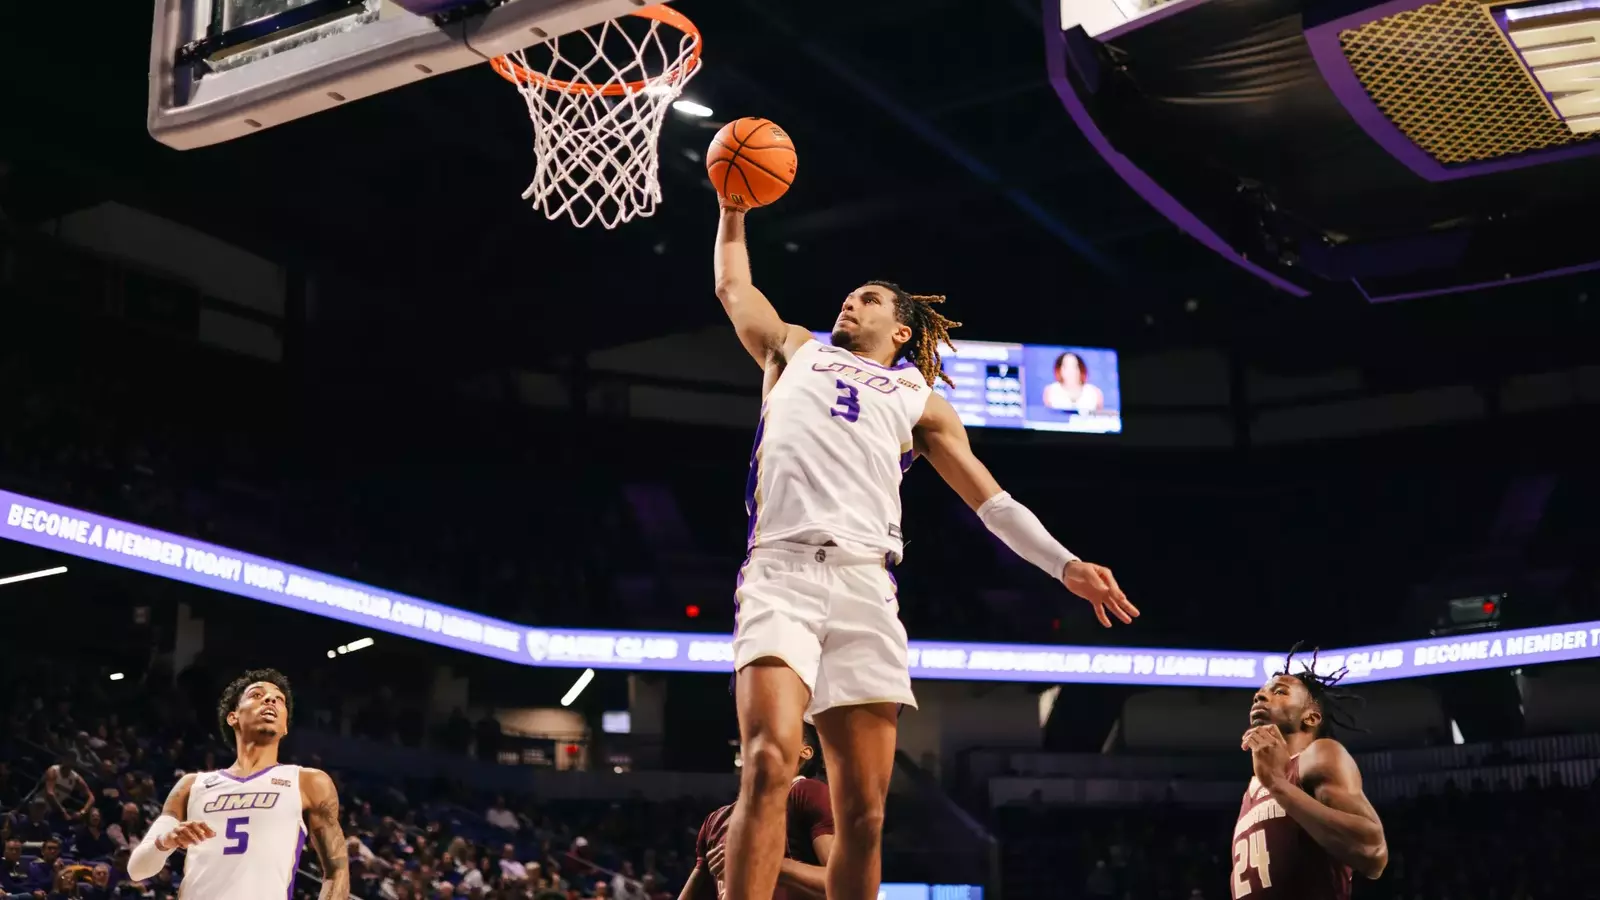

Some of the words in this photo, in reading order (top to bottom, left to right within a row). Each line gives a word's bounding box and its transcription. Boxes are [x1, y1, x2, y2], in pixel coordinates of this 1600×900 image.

[811, 362, 900, 394] JMU
[830, 379, 861, 423] 3
[7, 503, 90, 543] BECOME
[88, 524, 103, 548] A
[105, 527, 184, 568] MEMBER
[1414, 640, 1490, 666] BECOME
[1490, 638, 1503, 658] A
[1506, 630, 1588, 656] MEMBER
[204, 792, 280, 814] JMU
[223, 816, 250, 855] 5
[1234, 828, 1272, 900] 24
